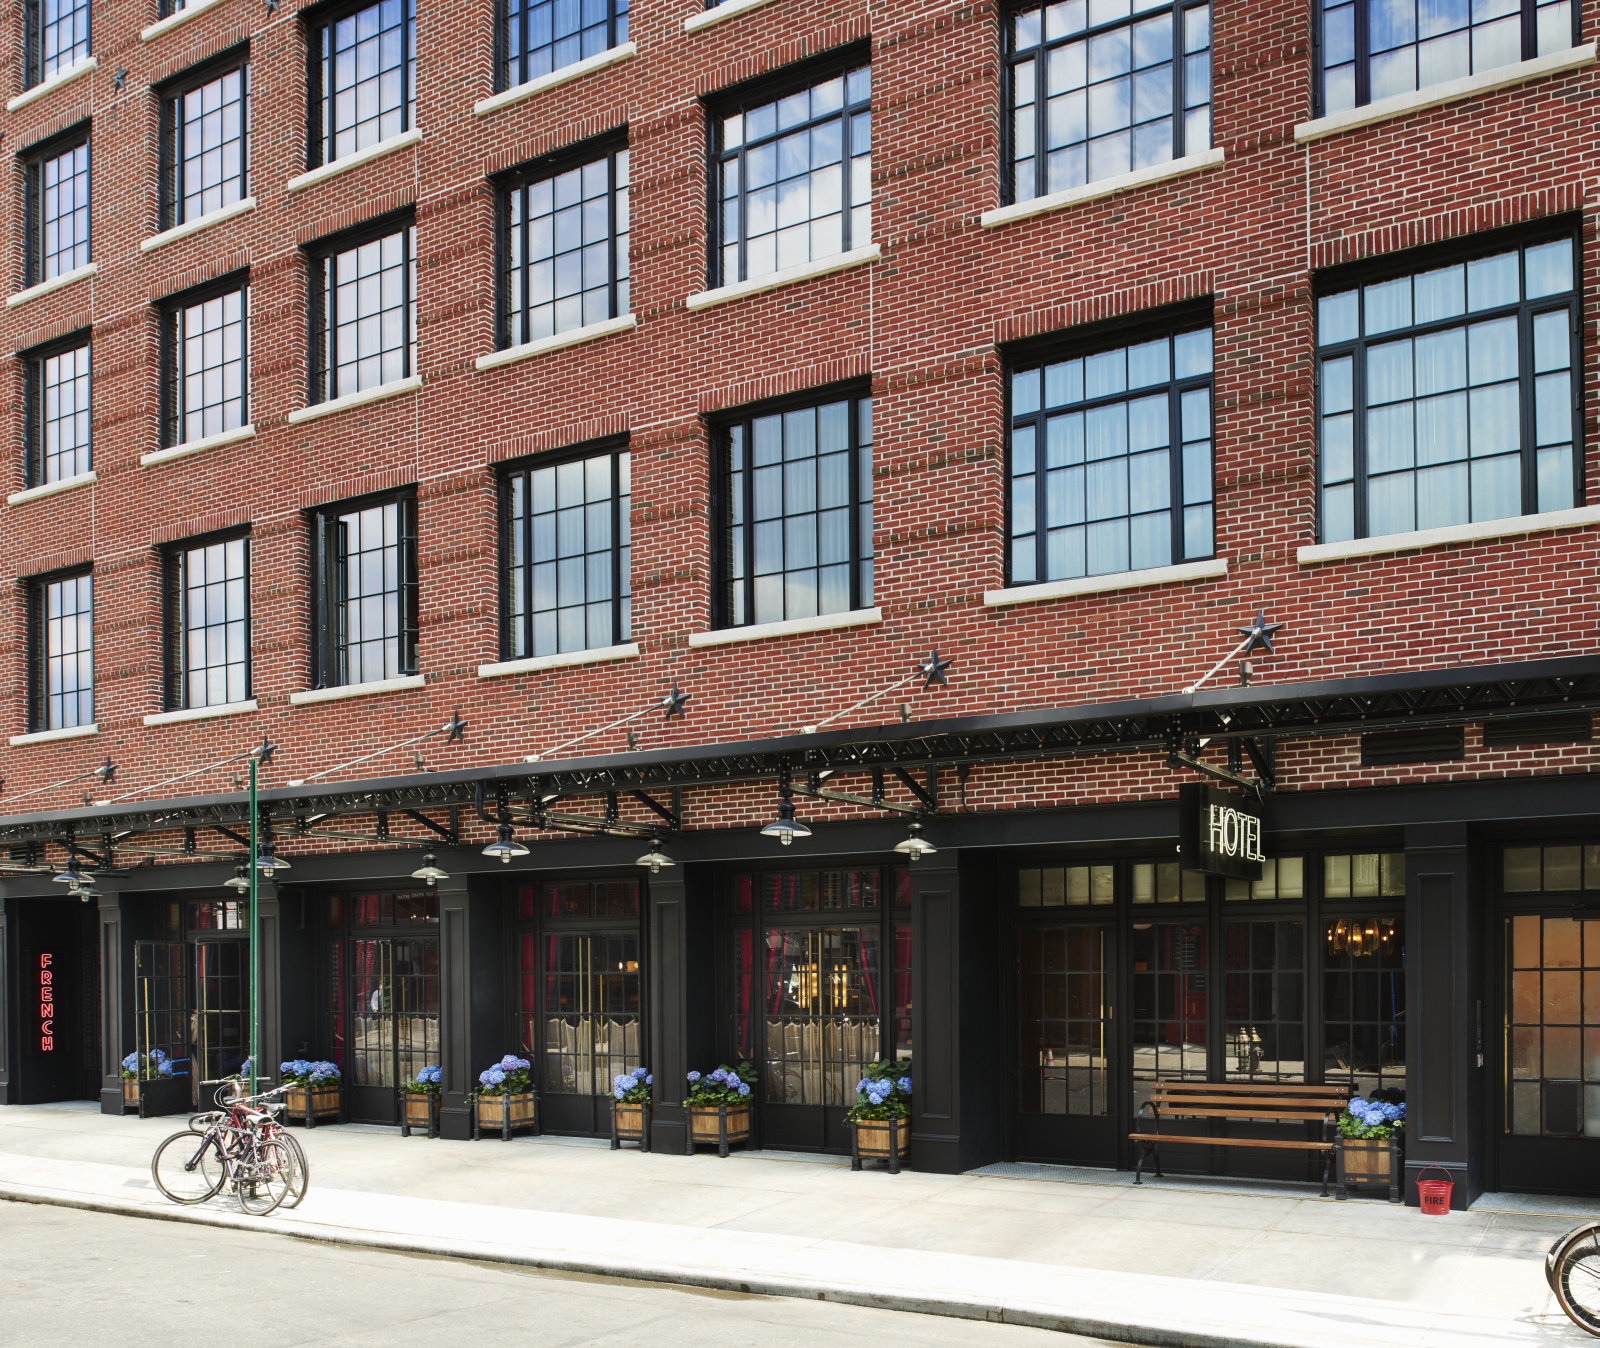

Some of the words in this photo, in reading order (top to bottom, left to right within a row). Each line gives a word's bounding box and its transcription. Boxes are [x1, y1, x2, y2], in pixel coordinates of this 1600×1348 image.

[1210, 804, 1265, 862] HOTEL
[41, 953, 53, 1051] FRENCH
[1424, 1196, 1444, 1205] FIRE
